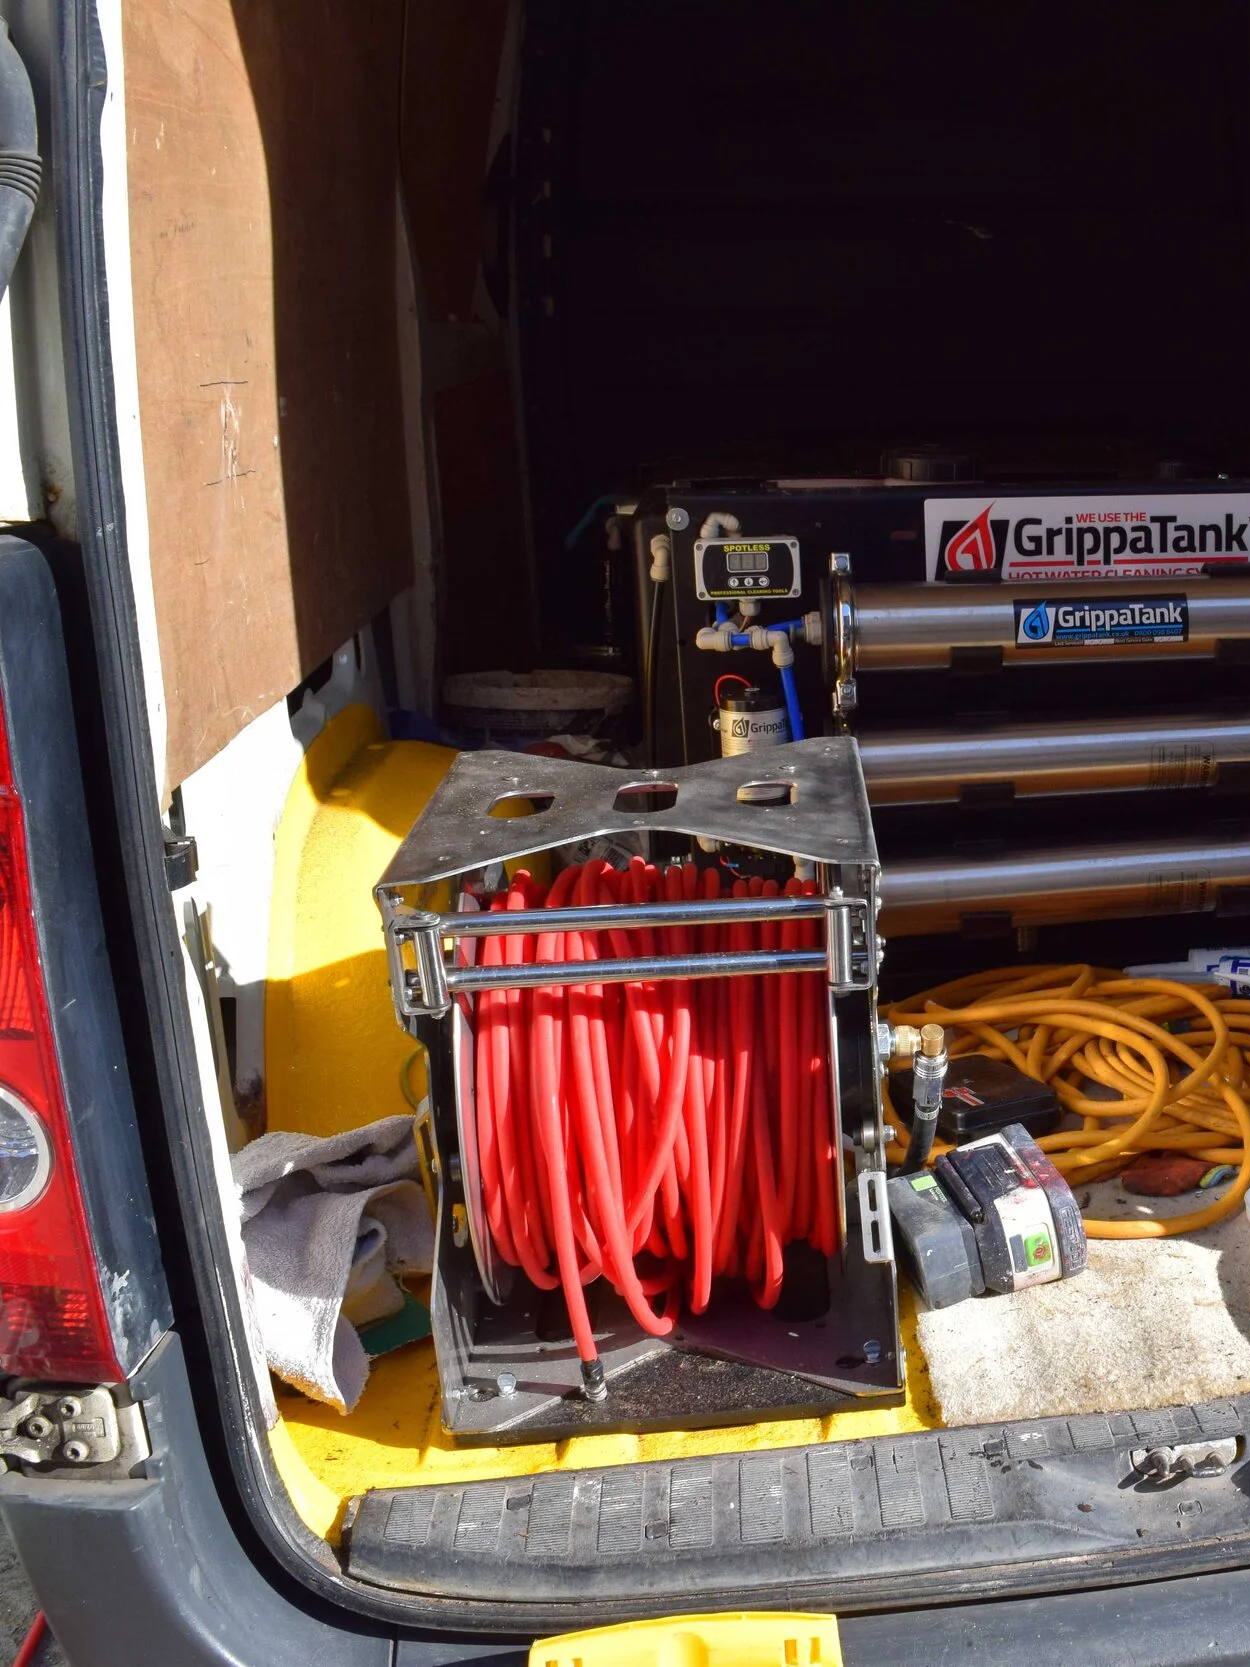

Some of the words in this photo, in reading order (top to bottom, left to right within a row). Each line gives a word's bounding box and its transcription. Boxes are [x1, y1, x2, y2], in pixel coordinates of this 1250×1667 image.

[1076, 513, 1097, 523] WE
[1098, 513, 1121, 522] USE
[1123, 512, 1147, 522] THE
[1013, 513, 1249, 566] GrippaTank
[724, 543, 771, 552] SPOTLESS
[1057, 602, 1183, 631] GrippaTank
[1056, 631, 1129, 640] www.grippatank.co.uk
